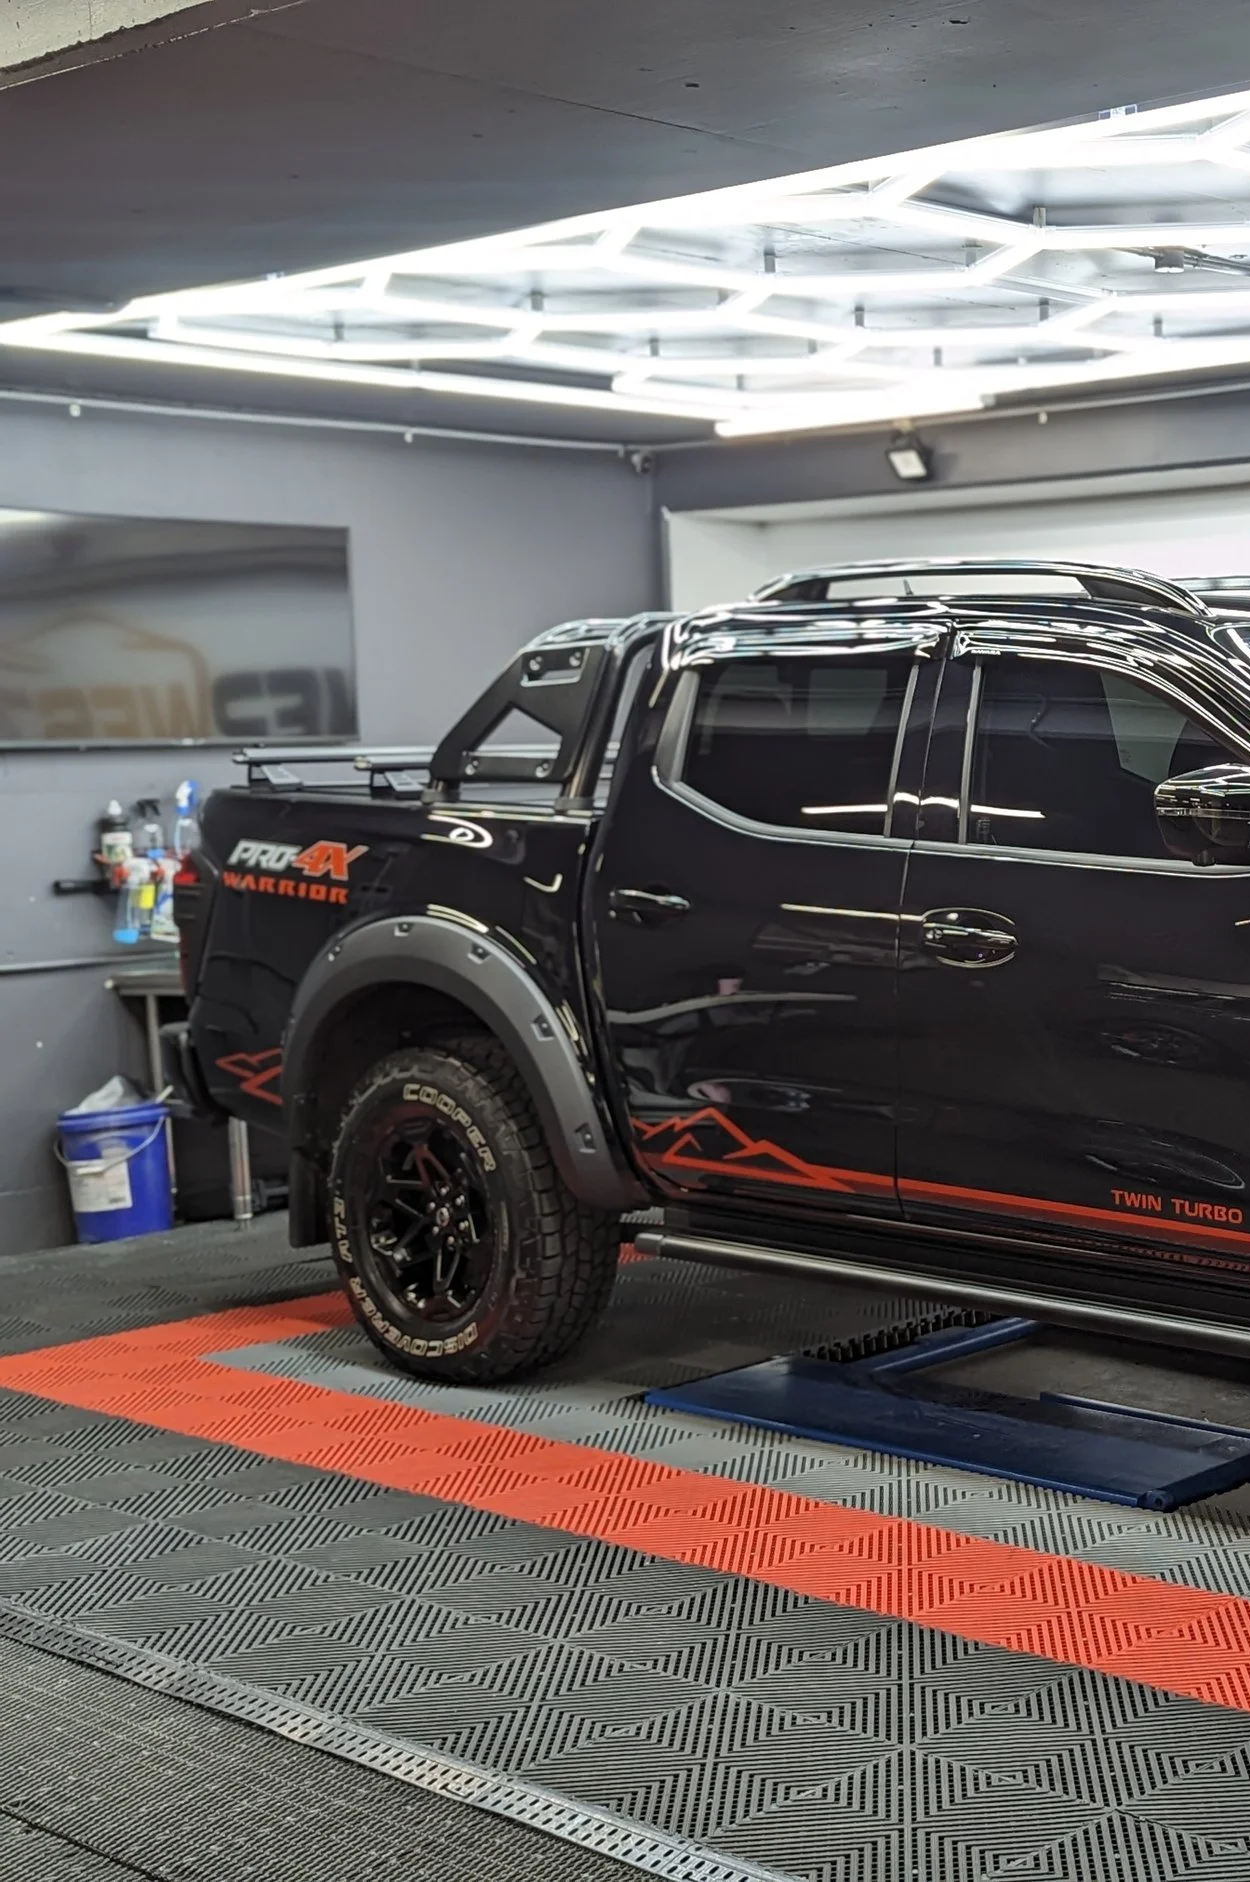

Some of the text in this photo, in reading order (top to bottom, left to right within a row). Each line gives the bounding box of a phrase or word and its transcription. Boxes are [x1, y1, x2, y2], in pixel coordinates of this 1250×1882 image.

[223, 871, 348, 904] WARRIOR
[403, 1083, 496, 1172] COOPER
[1111, 1189, 1243, 1224] TWIN TURBO
